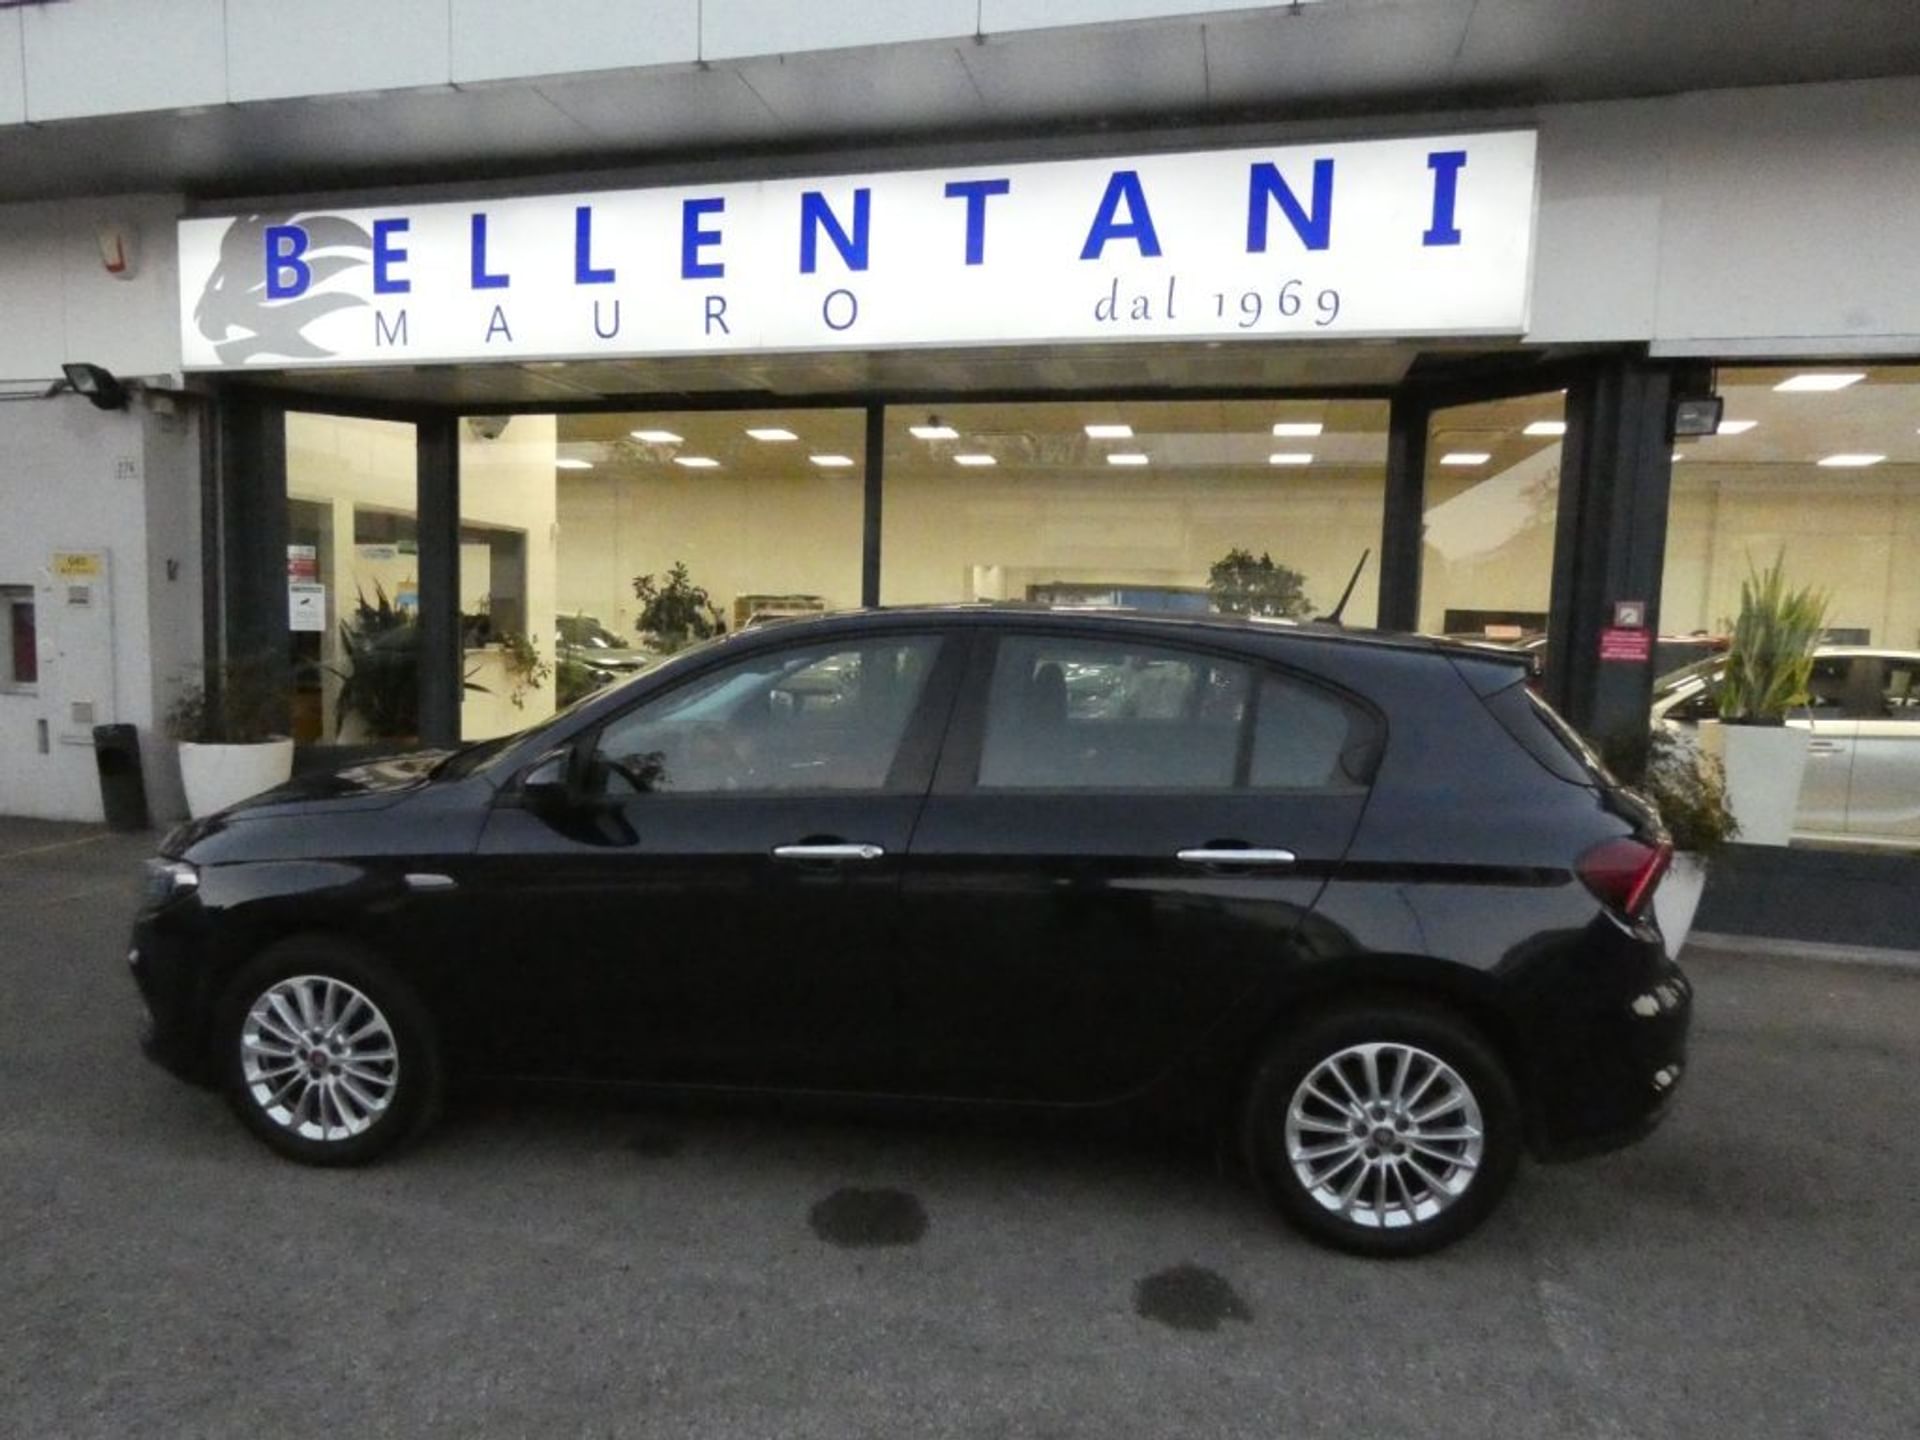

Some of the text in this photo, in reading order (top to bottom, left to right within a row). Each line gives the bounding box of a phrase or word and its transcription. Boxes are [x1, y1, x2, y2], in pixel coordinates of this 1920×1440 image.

[264, 150, 1467, 299] BELLENTANI
[374, 288, 860, 347] MAURO
[1093, 275, 1342, 328] dal 1969
